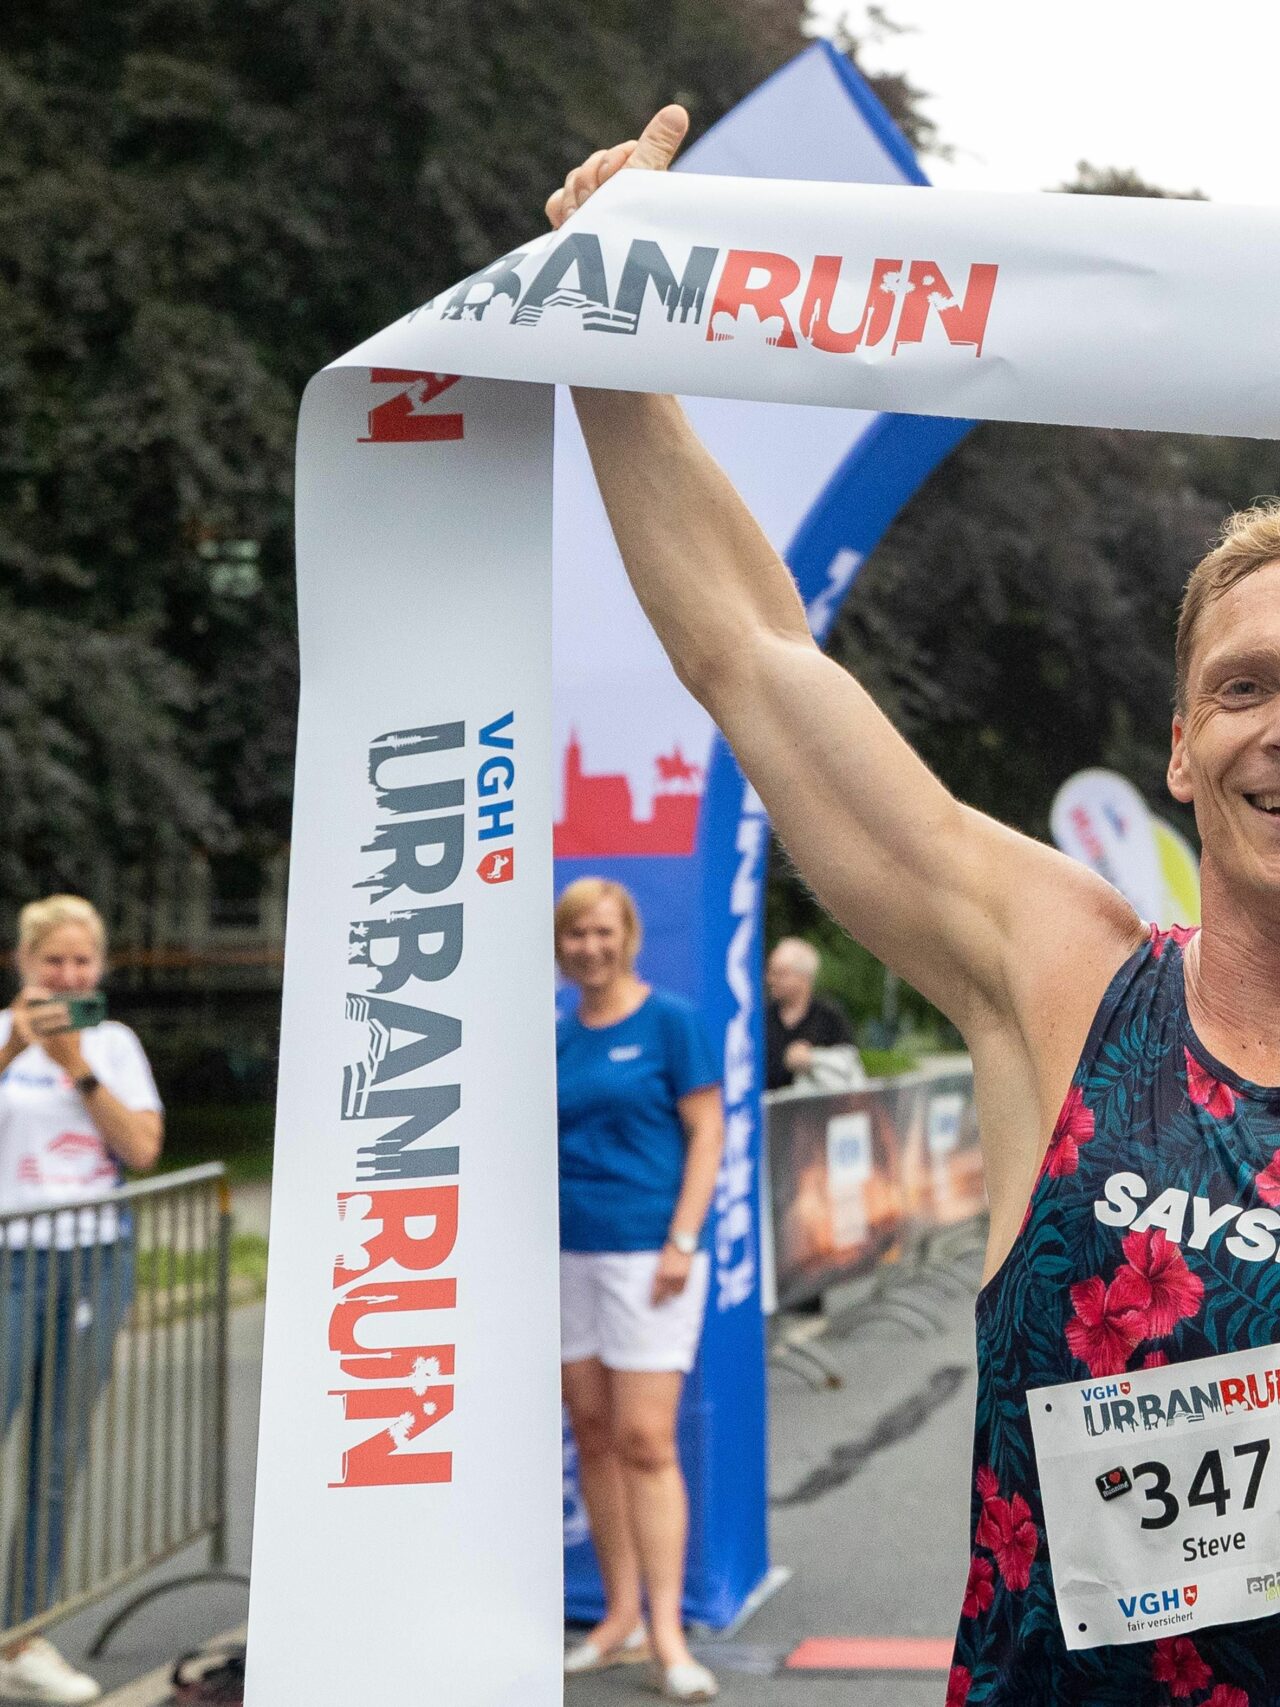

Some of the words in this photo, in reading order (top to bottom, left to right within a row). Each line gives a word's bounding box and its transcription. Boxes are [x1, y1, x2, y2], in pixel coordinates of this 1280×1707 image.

[408, 232, 999, 358] BANRUN
[477, 710, 515, 842] VGH
[327, 719, 466, 1489] URBANRUN
[1080, 1385, 1119, 1402] VGH
[1132, 1437, 1271, 1530] 347
[1182, 1531, 1247, 1562] Steve
[1117, 1588, 1180, 1619] VGH
[1127, 1620, 1145, 1633] fair
[1147, 1611, 1194, 1629] versichert
